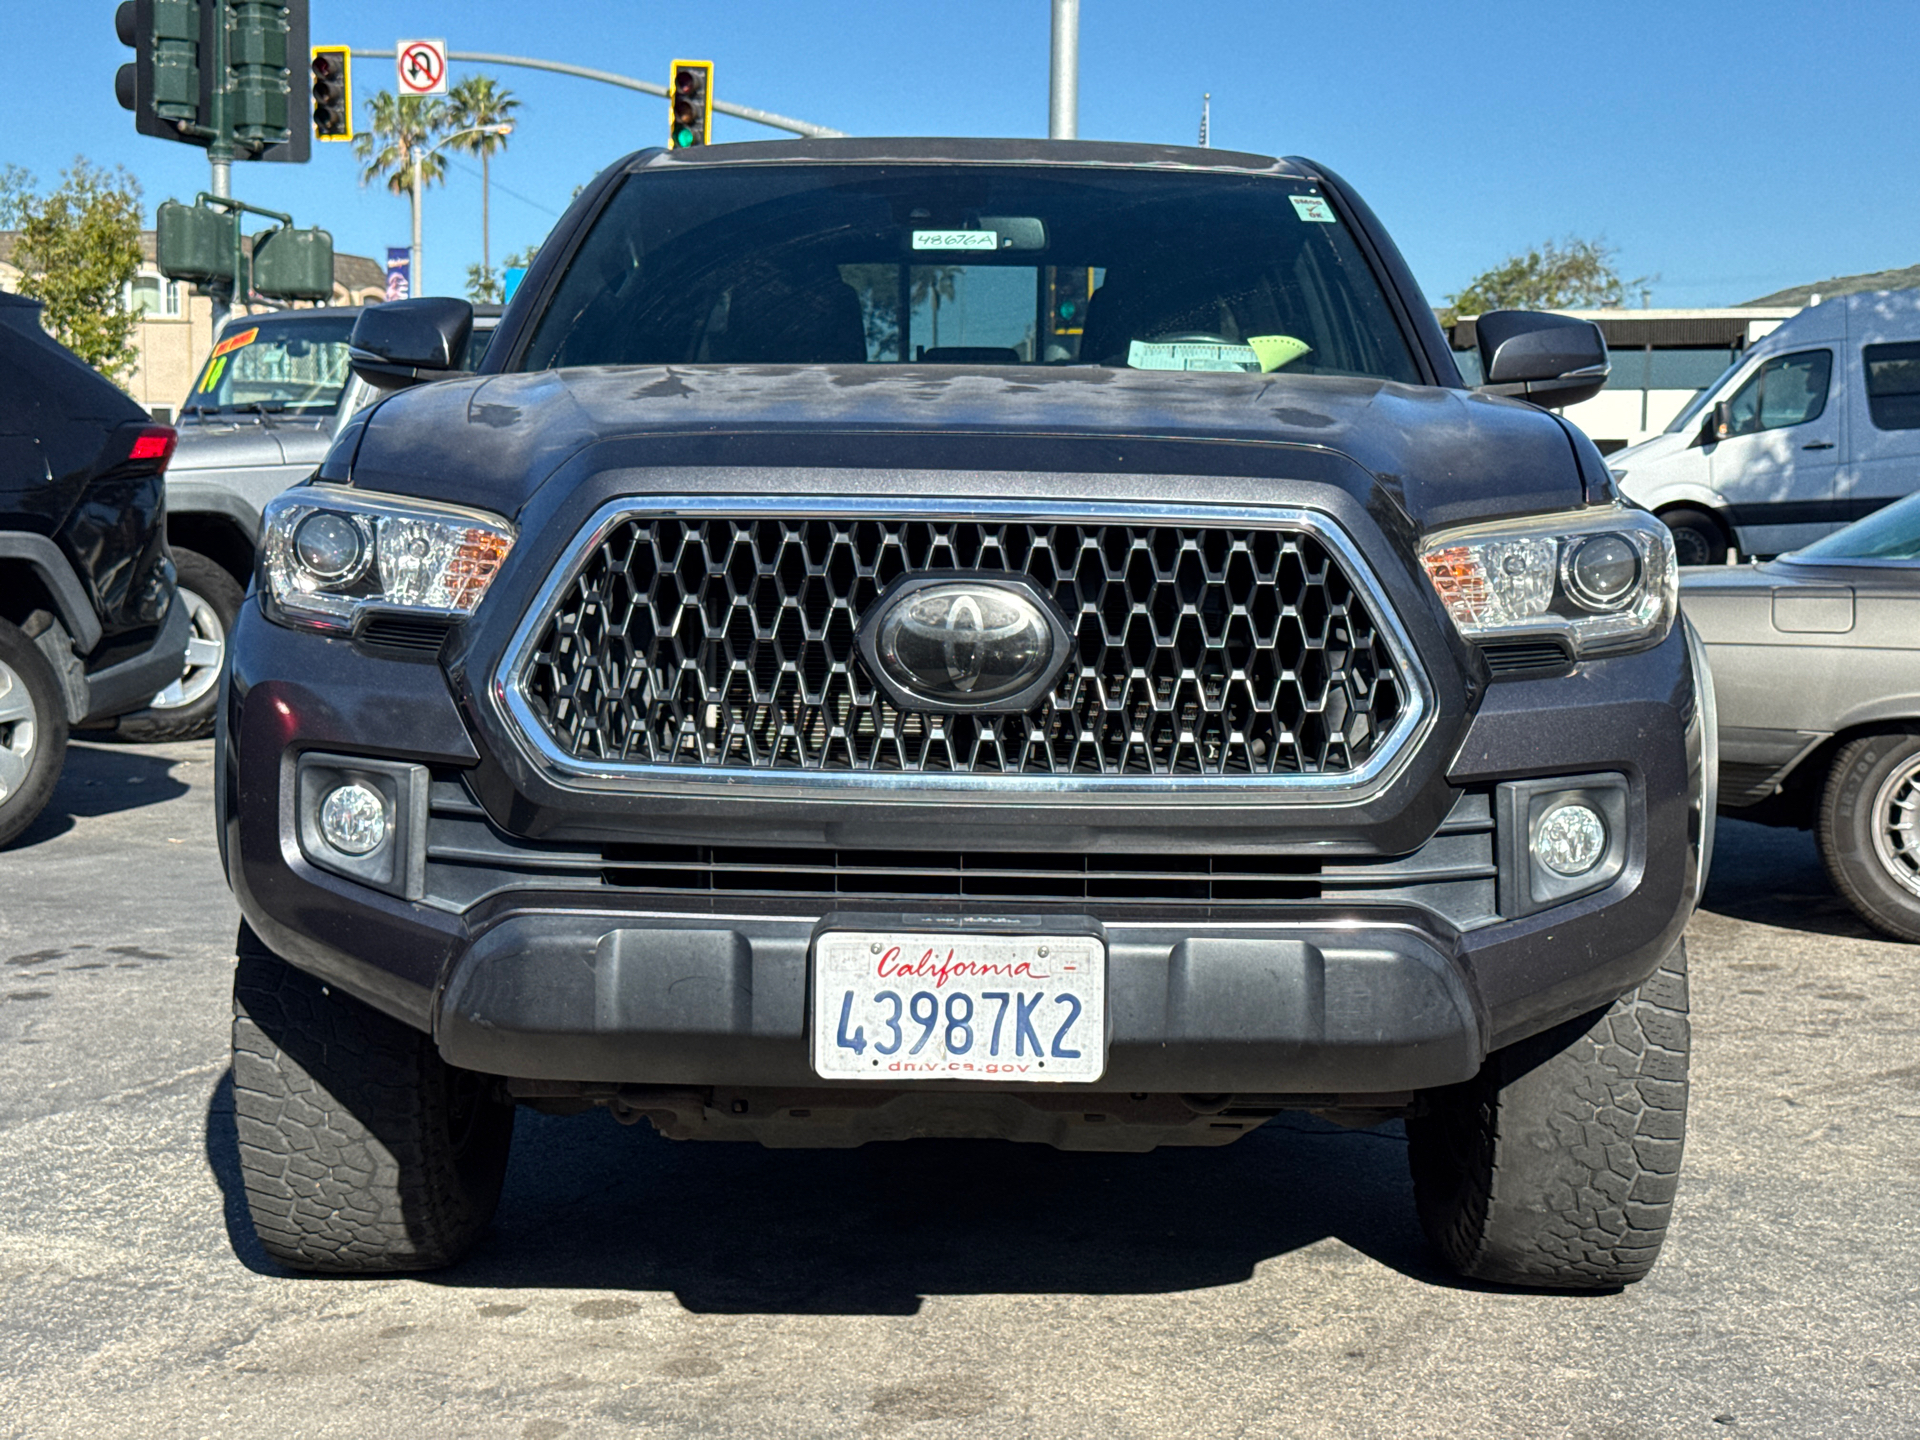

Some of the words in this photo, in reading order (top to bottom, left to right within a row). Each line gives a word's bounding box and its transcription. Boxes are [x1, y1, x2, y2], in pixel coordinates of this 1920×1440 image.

[917, 234, 994, 246] 48676A
[877, 946, 1051, 989] California
[836, 990, 1083, 1058] 43987K2
[888, 1061, 1031, 1074] dmv.ca.gov
